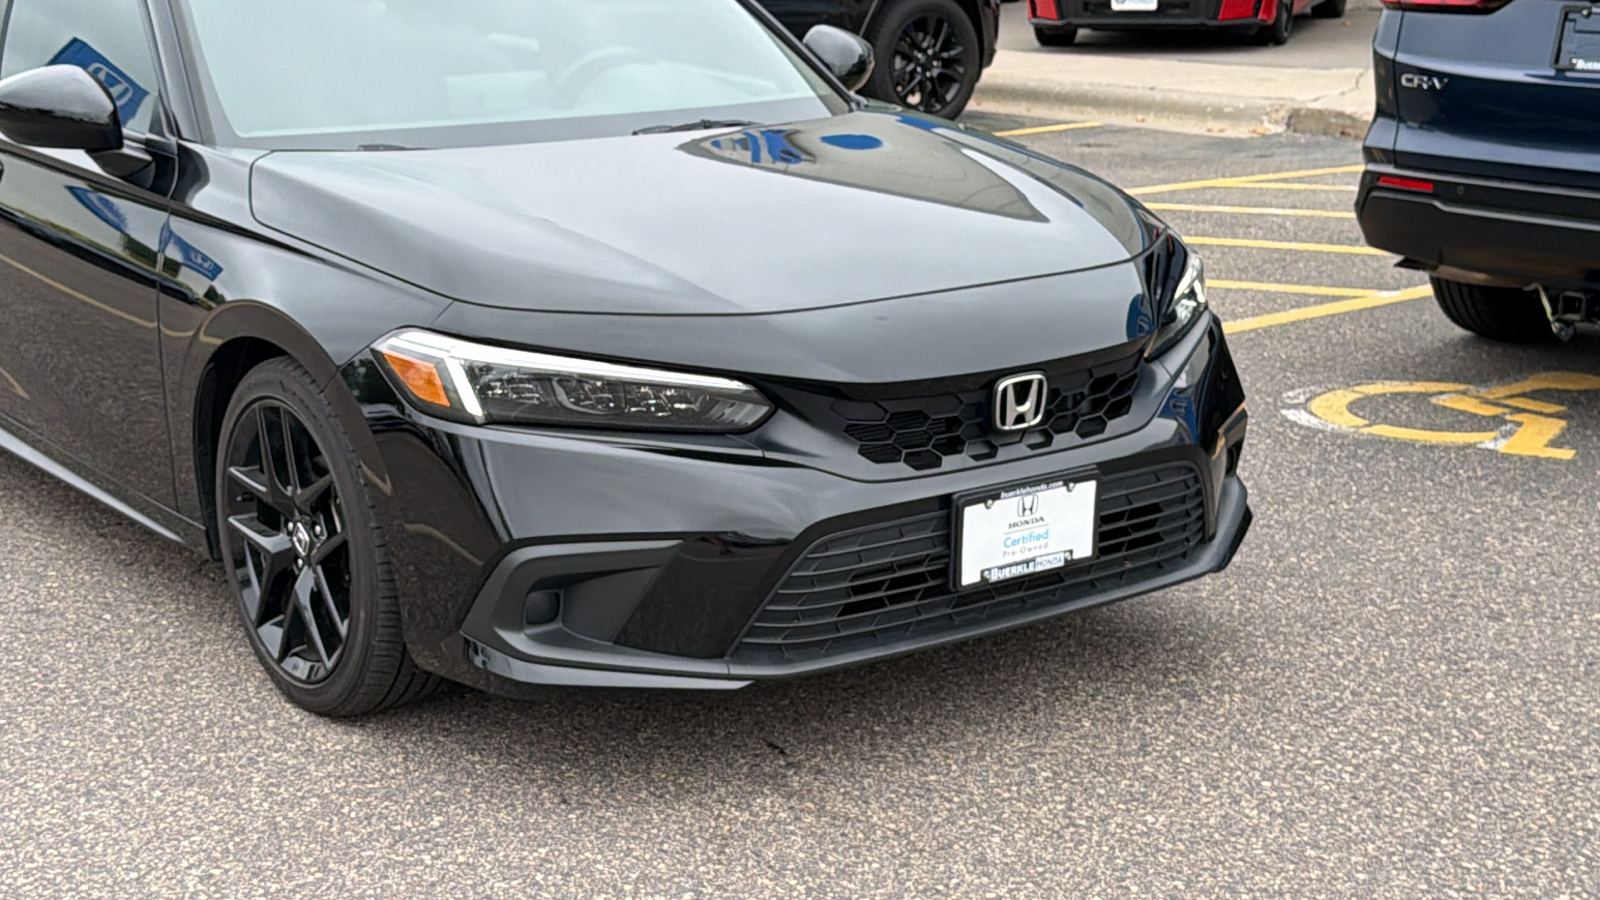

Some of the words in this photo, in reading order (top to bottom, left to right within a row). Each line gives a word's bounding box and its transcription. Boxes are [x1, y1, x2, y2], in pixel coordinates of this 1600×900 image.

[1008, 516, 1045, 529] HONDA
[1003, 528, 1049, 548] Certified
[1002, 542, 1049, 558] Pre-Owned
